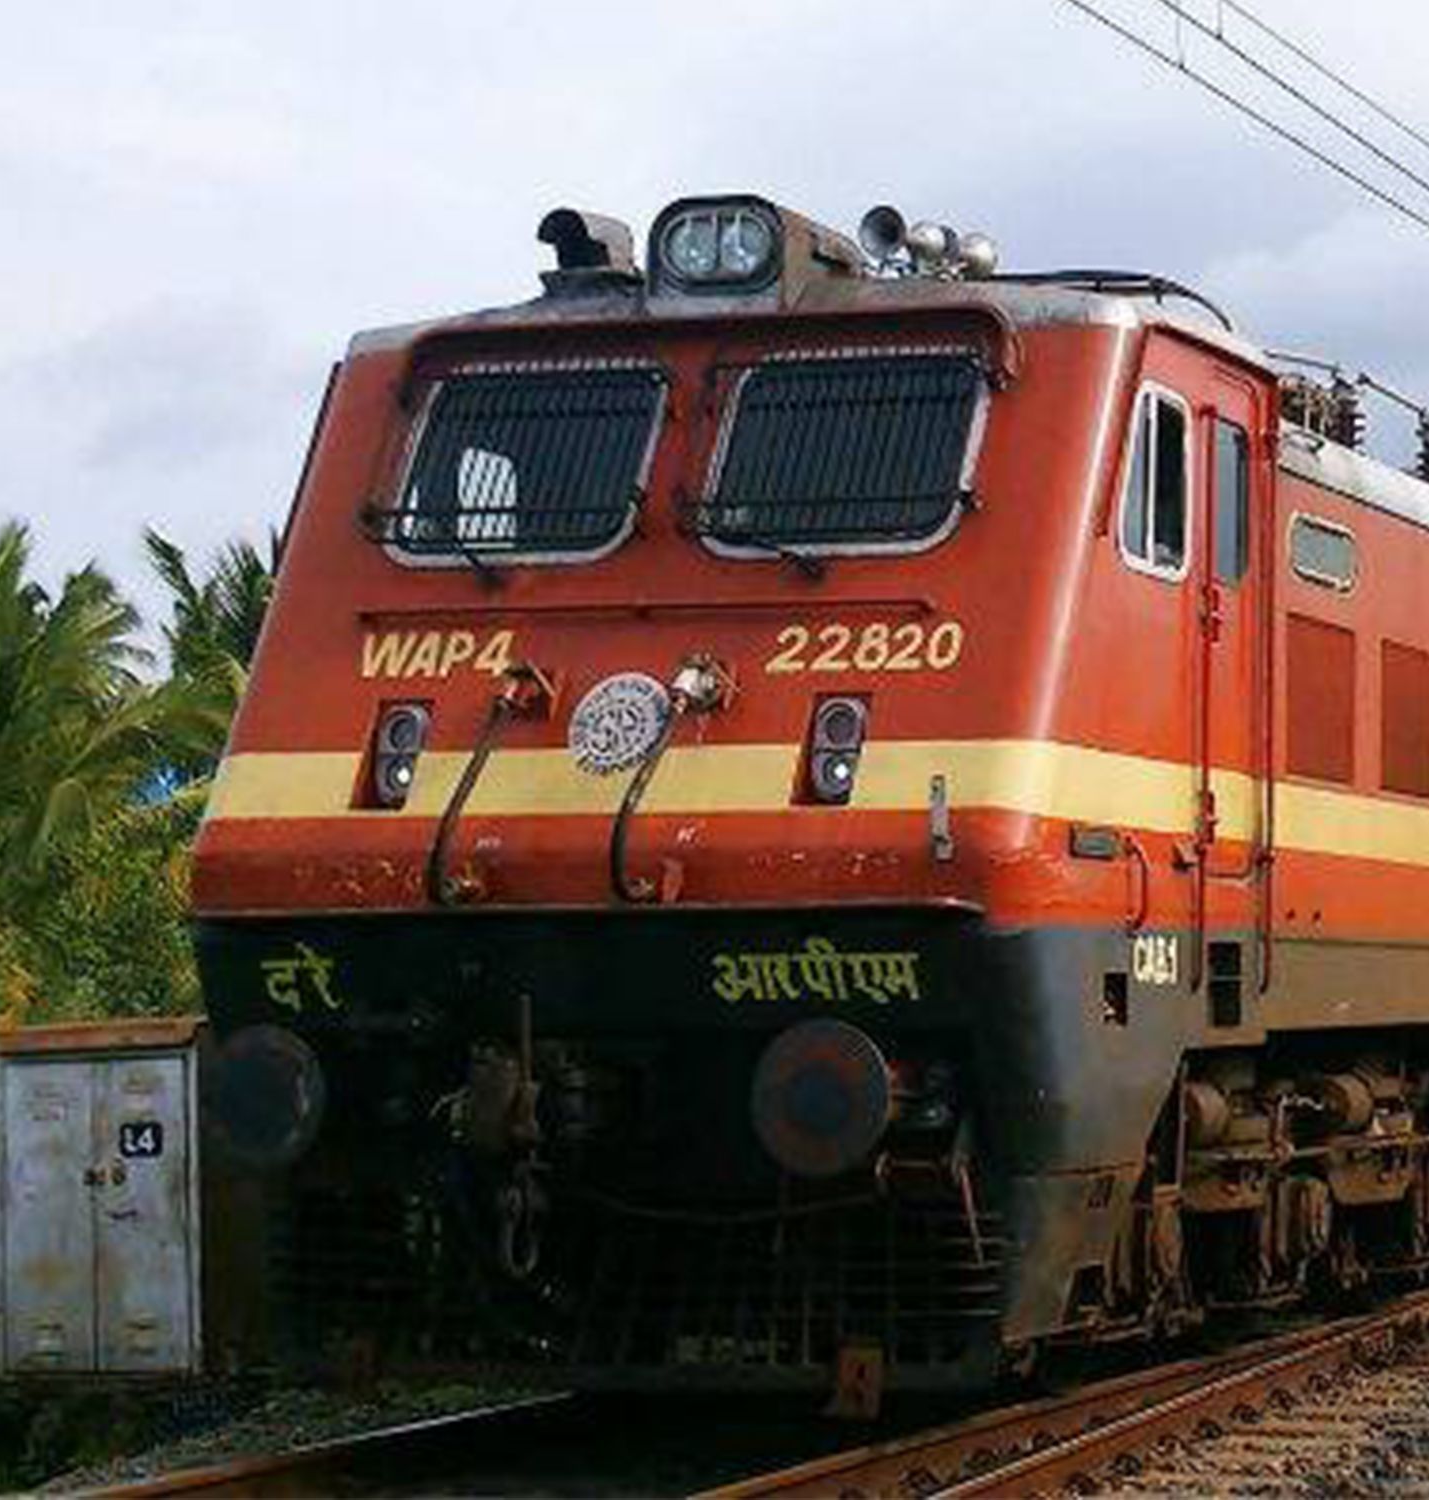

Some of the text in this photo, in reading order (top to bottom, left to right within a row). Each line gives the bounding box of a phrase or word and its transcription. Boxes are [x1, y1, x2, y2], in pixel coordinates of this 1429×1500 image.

[362, 630, 515, 678] WAP4
[765, 622, 962, 673] 22820
[713, 937, 919, 1003] आरपीएम
